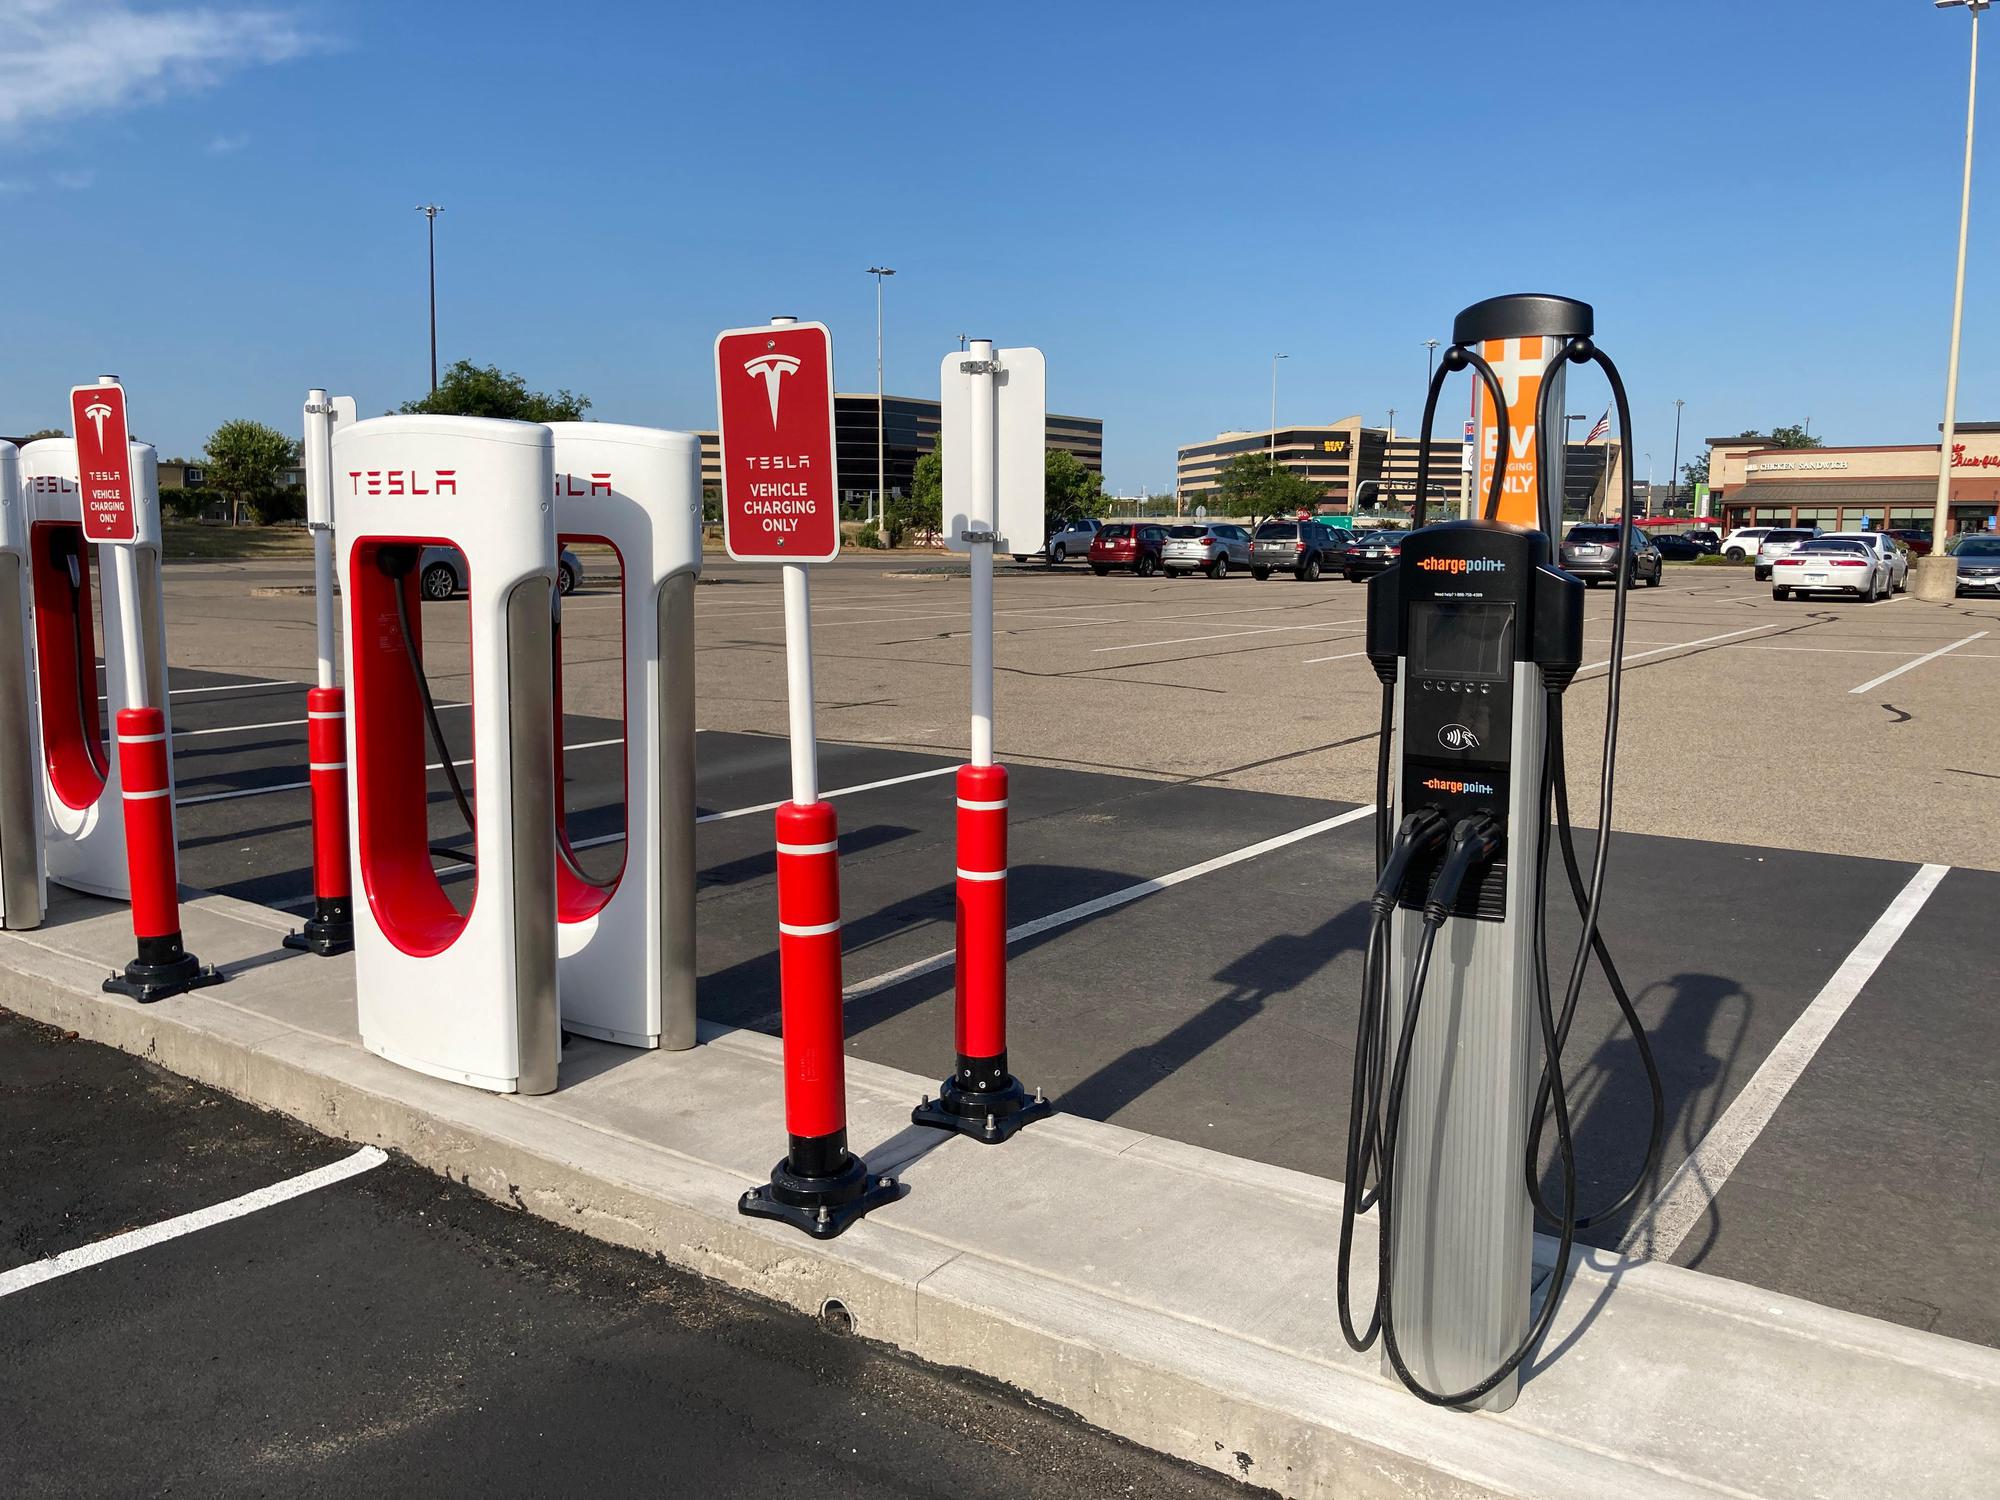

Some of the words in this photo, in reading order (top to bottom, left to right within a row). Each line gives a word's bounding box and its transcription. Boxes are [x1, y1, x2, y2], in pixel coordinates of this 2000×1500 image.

[1485, 425, 1535, 459] EV
[745, 455, 810, 470] TESLA
[1483, 462, 1533, 472] CHGING
[1760, 463, 1795, 471] CHICKEN
[1798, 461, 1848, 470] SANDWICH
[89, 471, 120, 481] TESLA
[349, 470, 457, 495] TESLA
[92, 489, 120, 499] VEHICLE
[750, 482, 808, 497] VEHICLE
[90, 501, 125, 511] CHARGING
[743, 500, 816, 515] CHARGING
[99, 513, 117, 523] ONLY
[762, 518, 799, 533] ONLY
